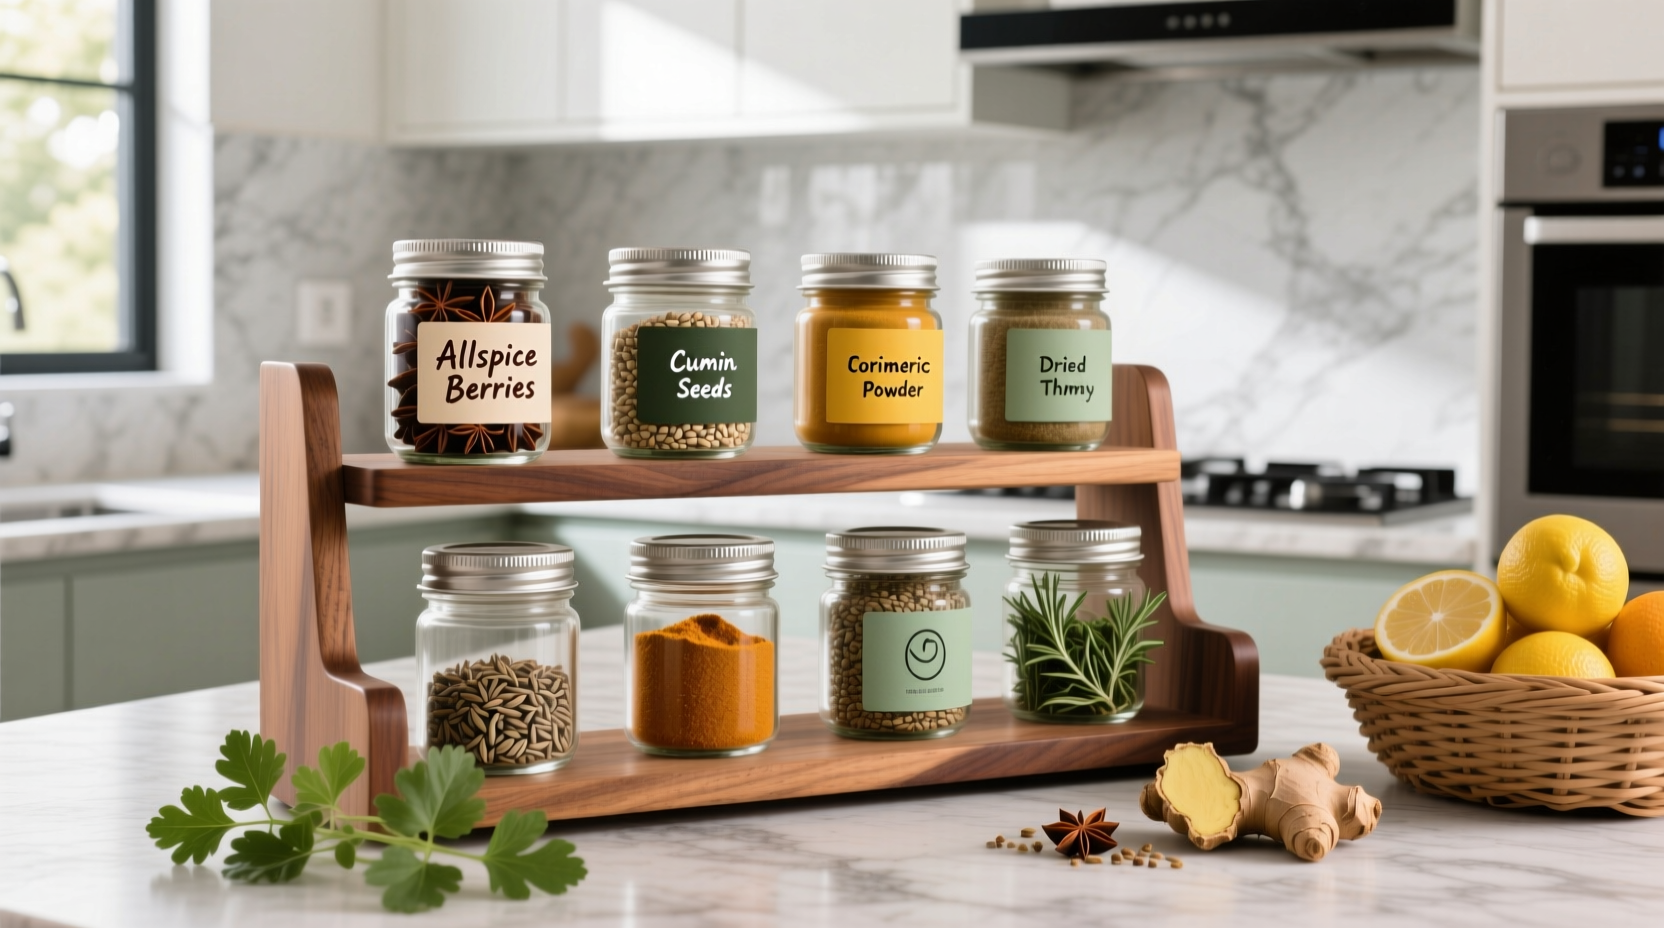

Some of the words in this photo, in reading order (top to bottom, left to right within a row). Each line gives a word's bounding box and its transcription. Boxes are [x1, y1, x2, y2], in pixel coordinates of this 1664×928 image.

[436, 340, 538, 378] Allspice
[671, 349, 737, 373] Cumin
[848, 355, 930, 373] Corimeric
[1040, 355, 1087, 373] Dried
[446, 374, 535, 404] Berries
[677, 376, 732, 399] Seeds
[863, 380, 924, 398] Powder
